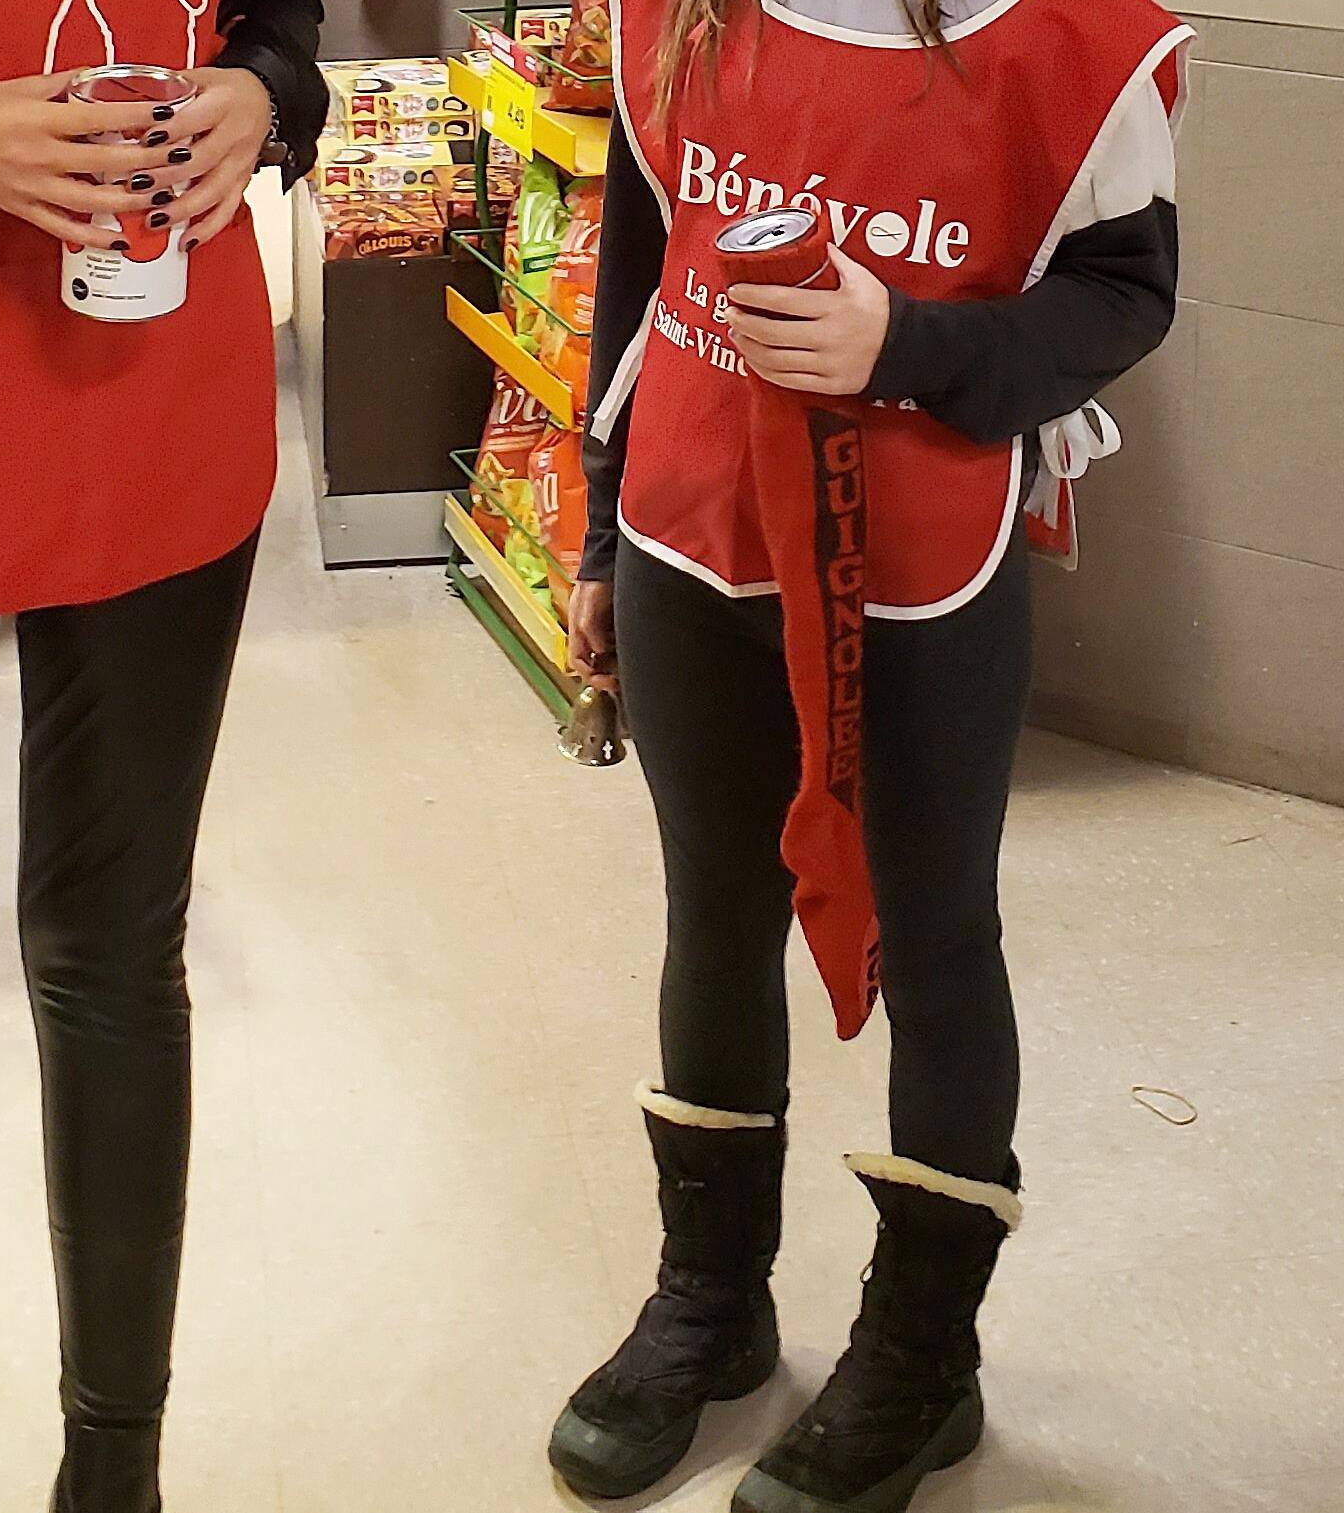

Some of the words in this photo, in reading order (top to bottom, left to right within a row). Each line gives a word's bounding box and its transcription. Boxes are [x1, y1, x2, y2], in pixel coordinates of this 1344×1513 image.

[677, 137, 970, 268] Bénévole
[683, 267, 708, 309] La
[653, 299, 749, 377] Saint-Vinc
